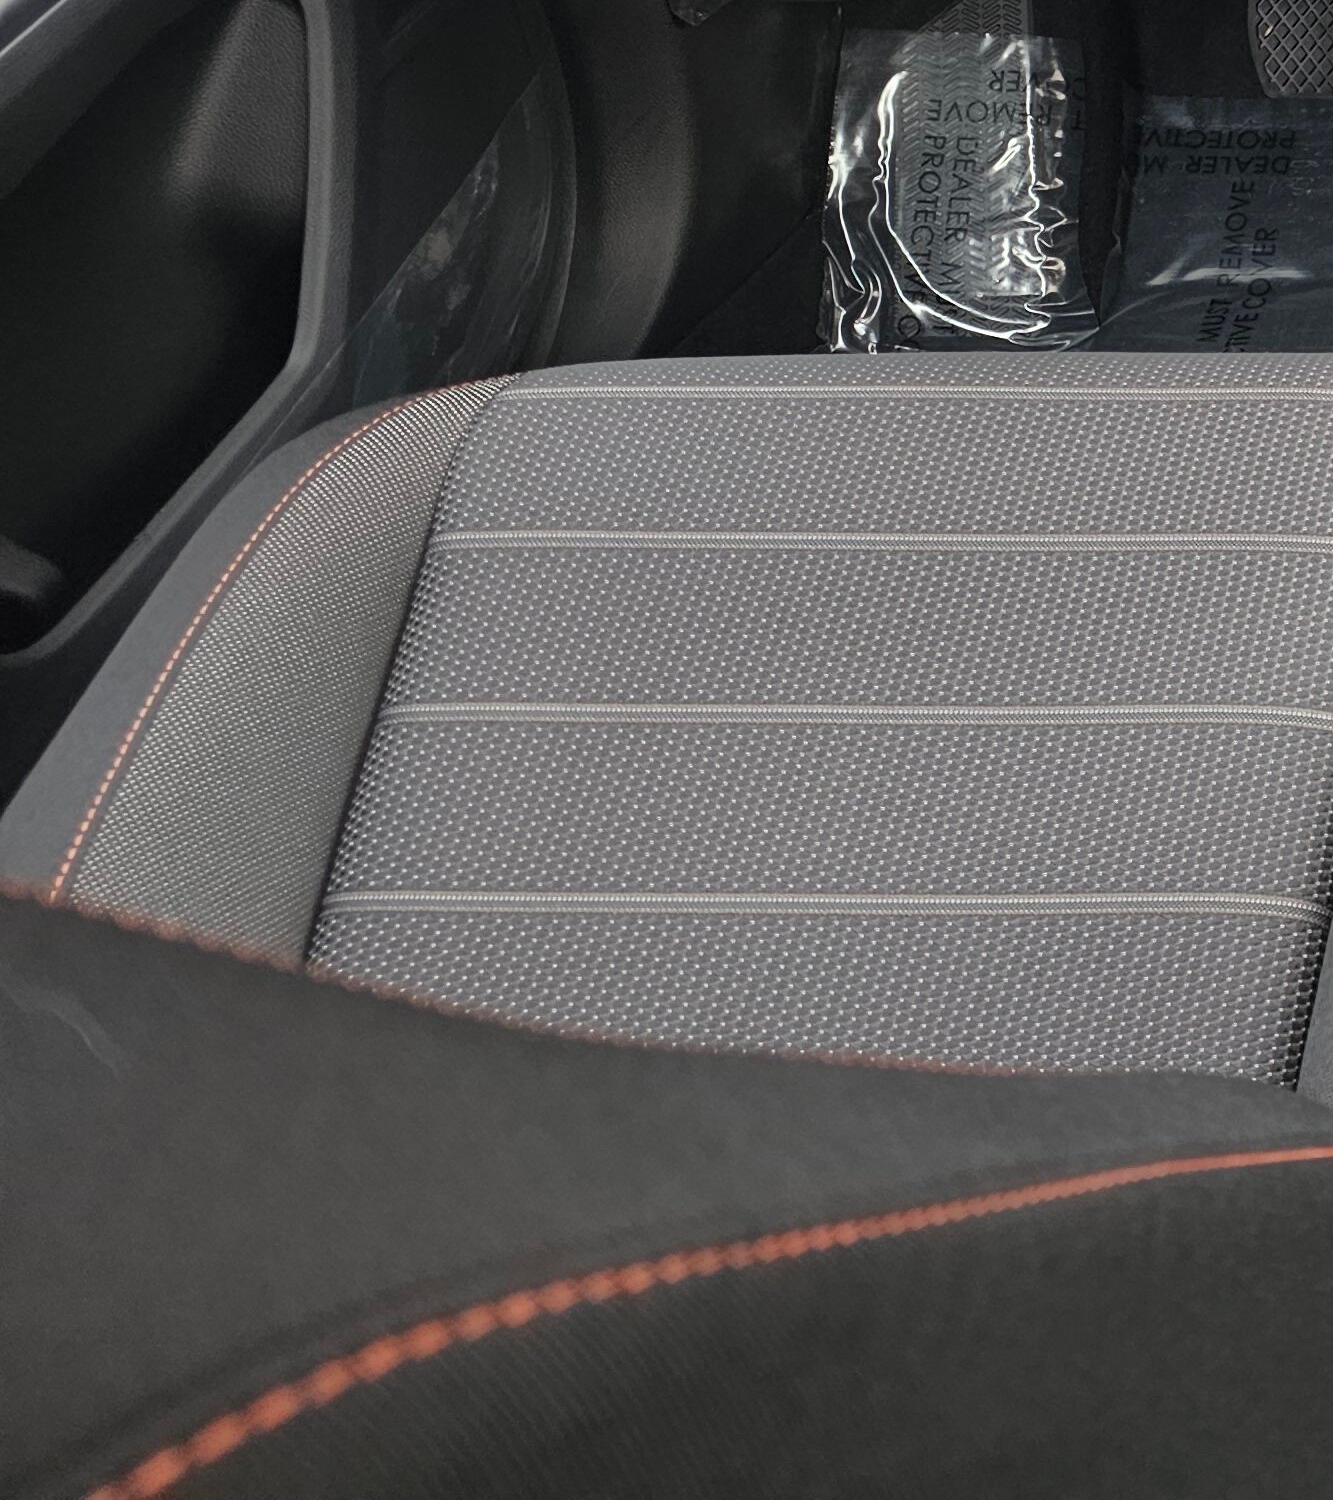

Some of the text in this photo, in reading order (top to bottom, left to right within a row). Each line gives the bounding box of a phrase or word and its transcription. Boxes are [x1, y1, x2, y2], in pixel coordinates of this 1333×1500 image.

[1216, 180, 1255, 289] REMOVE
[1242, 226, 1279, 311] COVER
[1198, 298, 1234, 343] MUST
